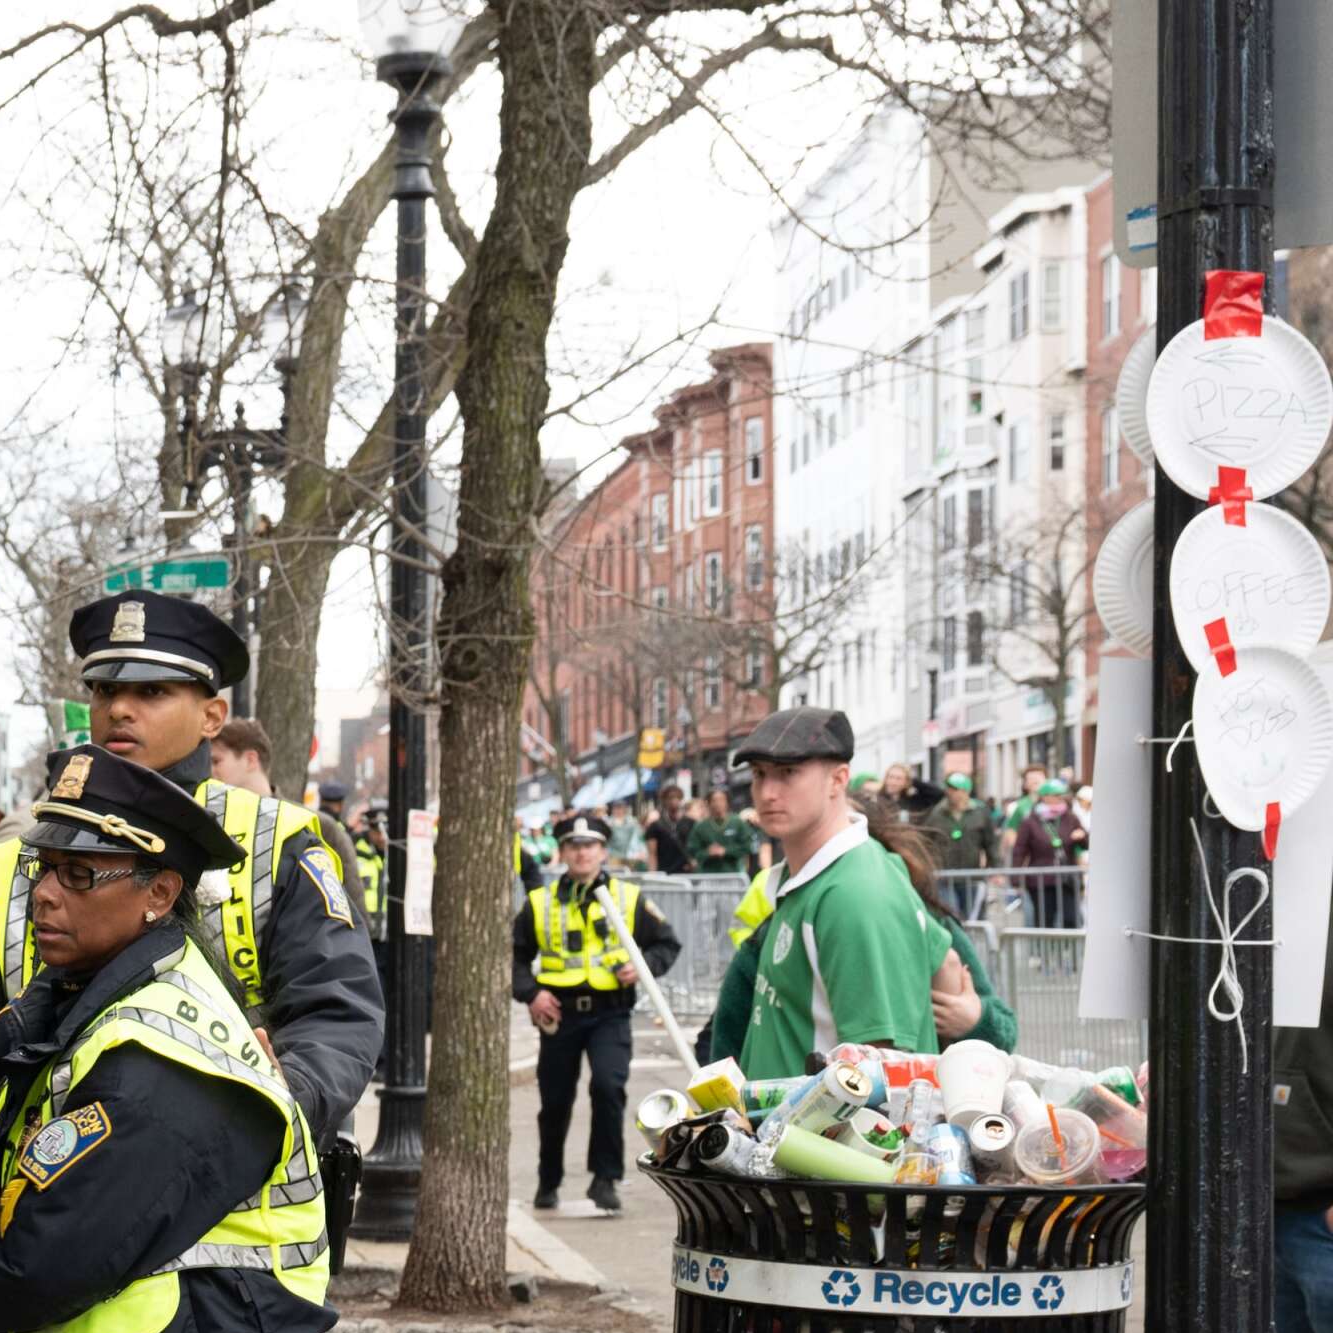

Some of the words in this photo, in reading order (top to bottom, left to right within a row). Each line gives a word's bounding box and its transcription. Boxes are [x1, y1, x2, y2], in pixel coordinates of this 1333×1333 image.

[1182, 376, 1308, 426] PIZZA
[1180, 571, 1311, 616] COFFEE
[175, 999, 278, 1077] BOS
[873, 1271, 1022, 1313] Recycle
